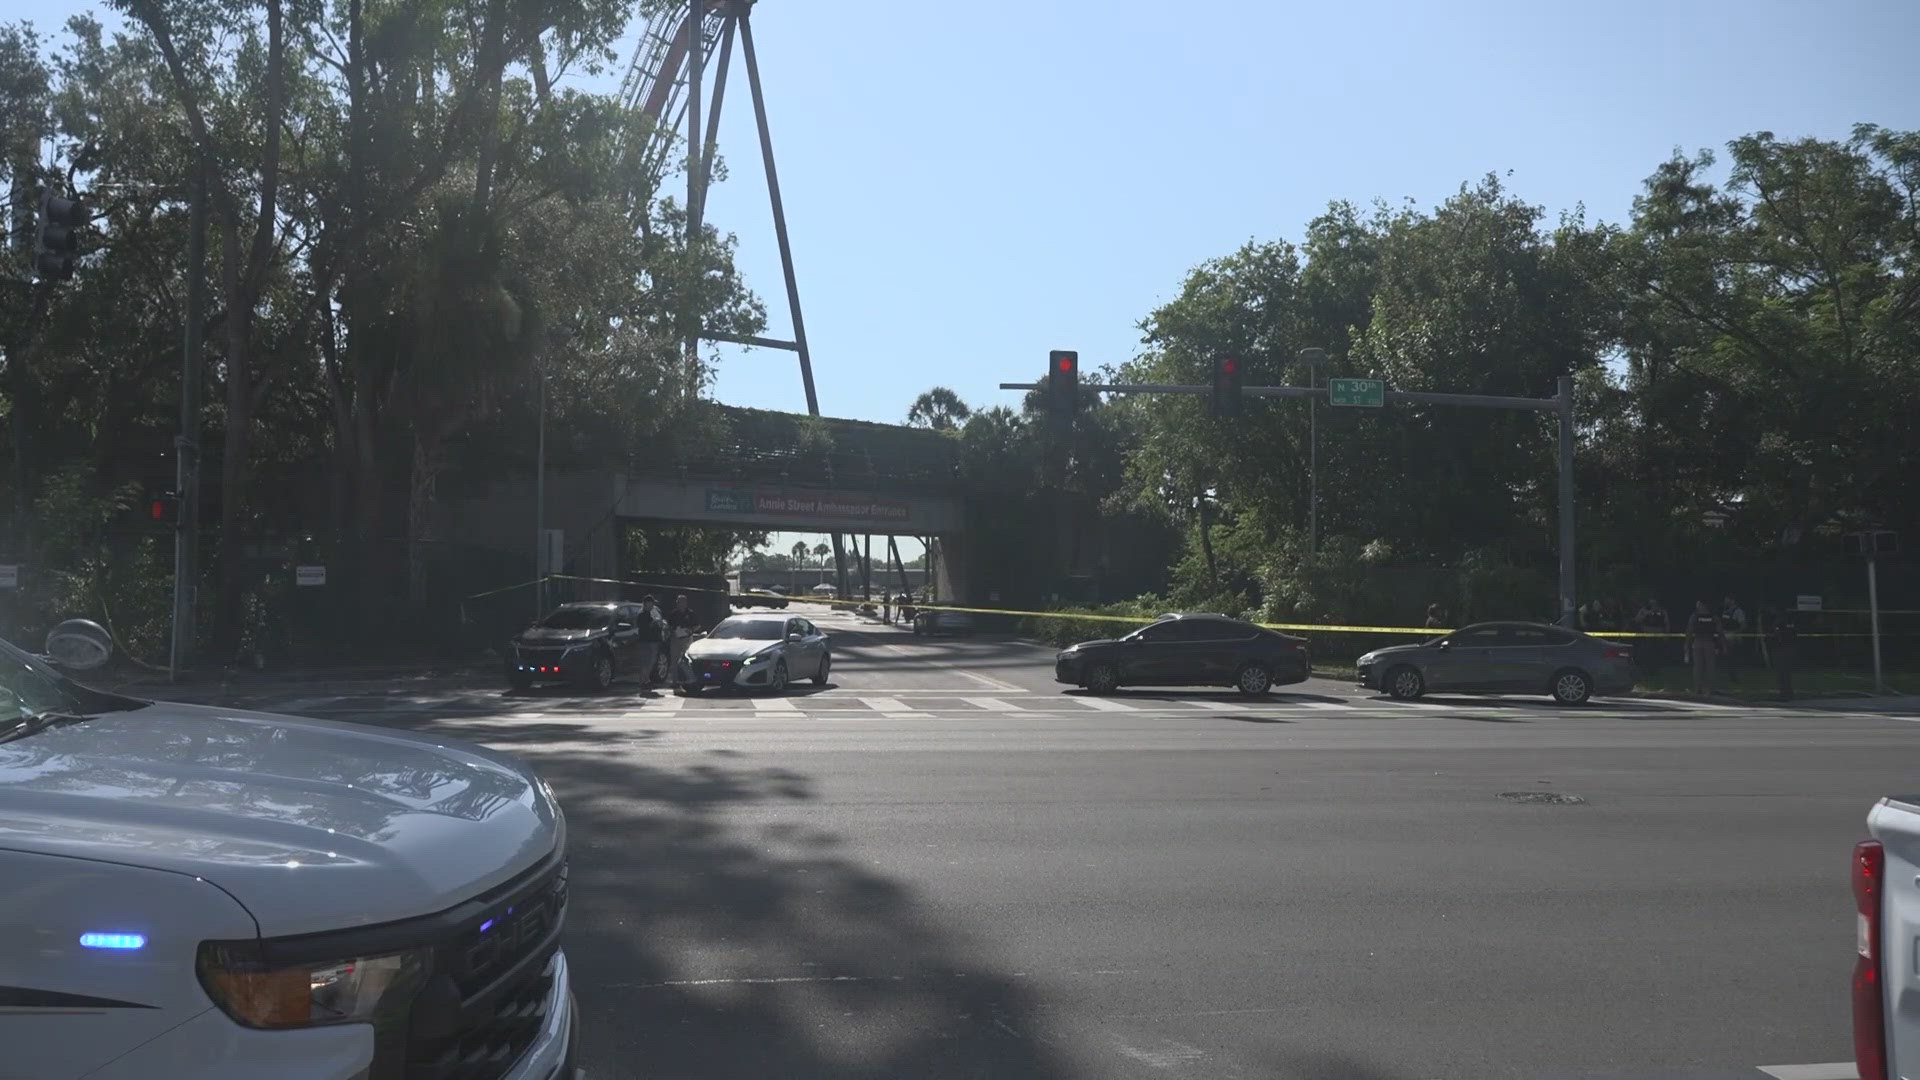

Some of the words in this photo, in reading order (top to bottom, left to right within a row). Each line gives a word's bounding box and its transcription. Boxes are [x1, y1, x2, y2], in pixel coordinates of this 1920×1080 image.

[1337, 383, 1345, 392] N
[759, 497, 785, 510] Annie
[787, 499, 815, 512] Street
